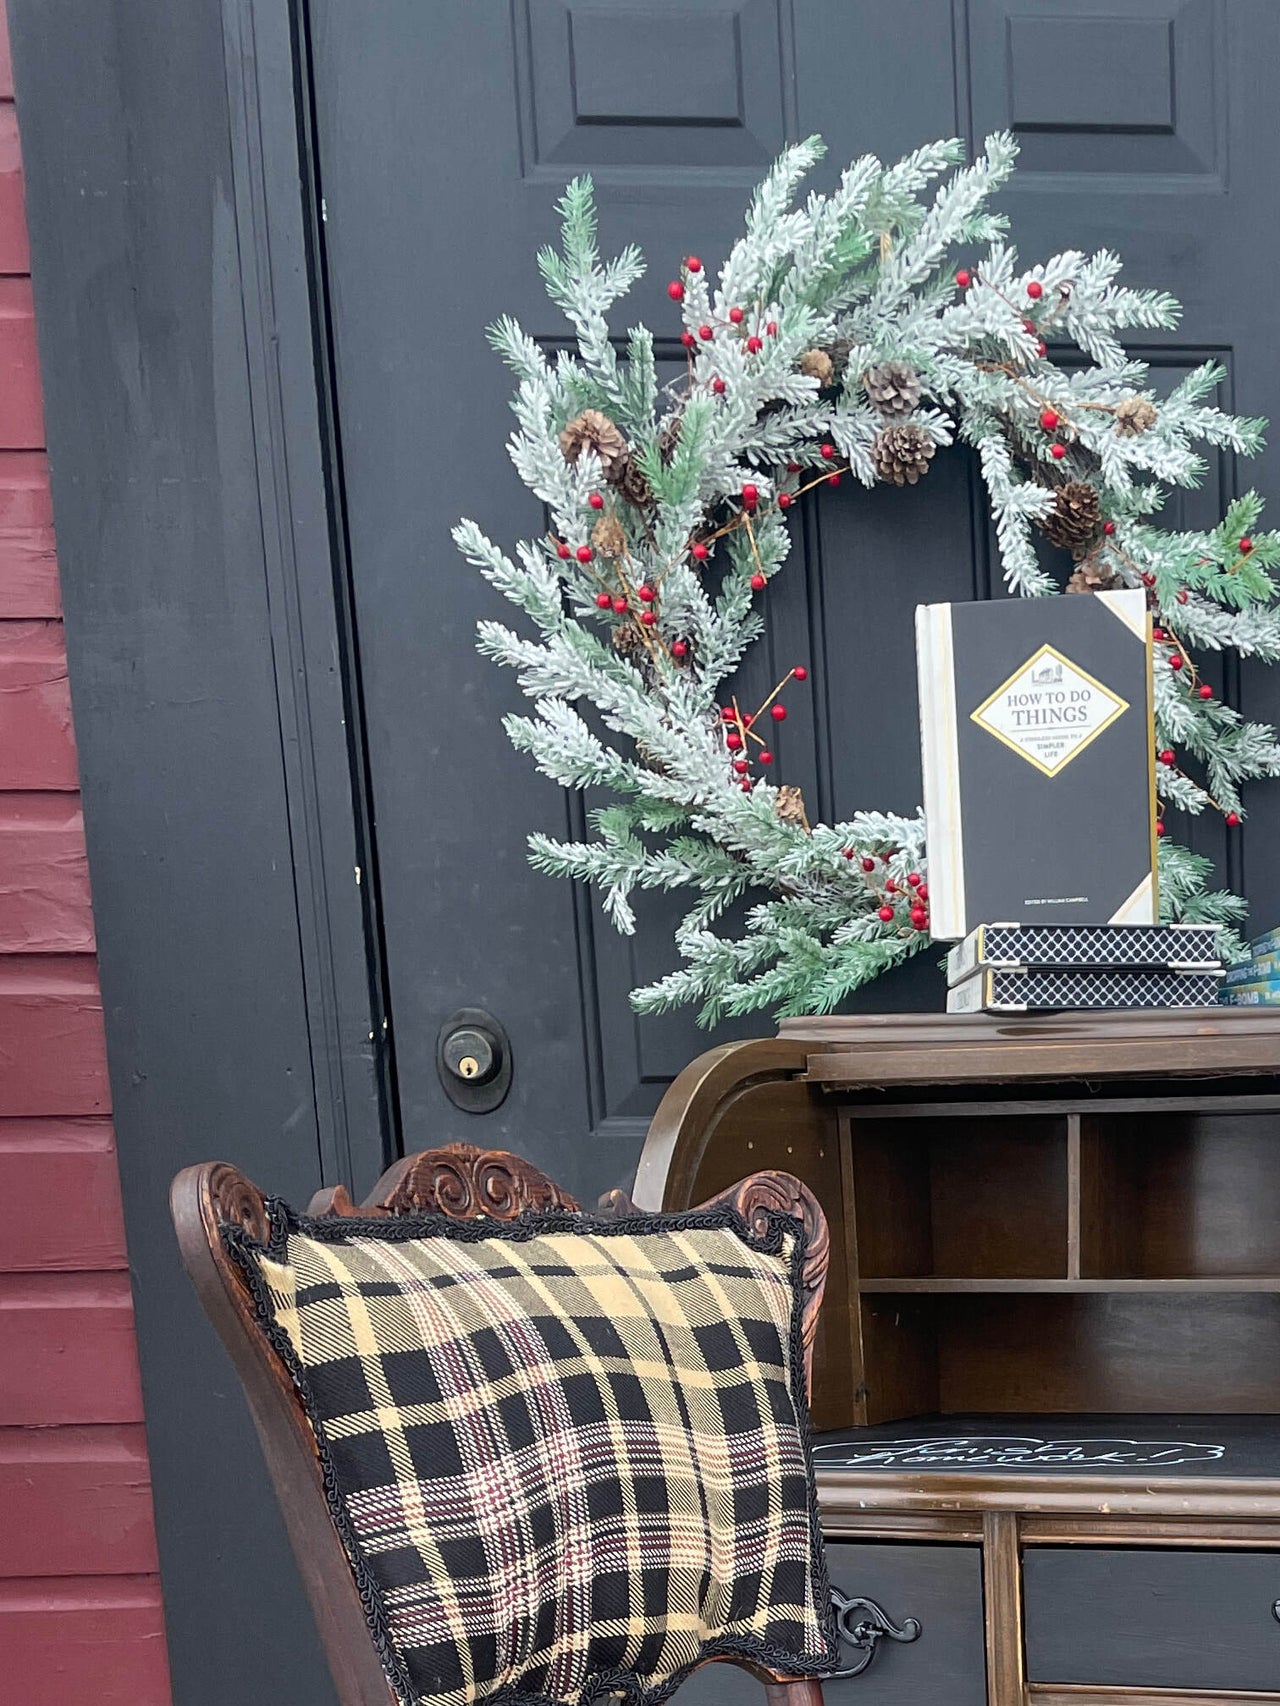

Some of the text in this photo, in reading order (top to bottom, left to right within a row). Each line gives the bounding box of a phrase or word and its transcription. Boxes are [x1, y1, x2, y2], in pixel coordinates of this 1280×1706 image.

[1007, 689, 1091, 707] HOW TO DO
[1011, 705, 1088, 726] THINGS
[1036, 742, 1065, 750] SIMPLER
[1044, 750, 1058, 758] LIFE
